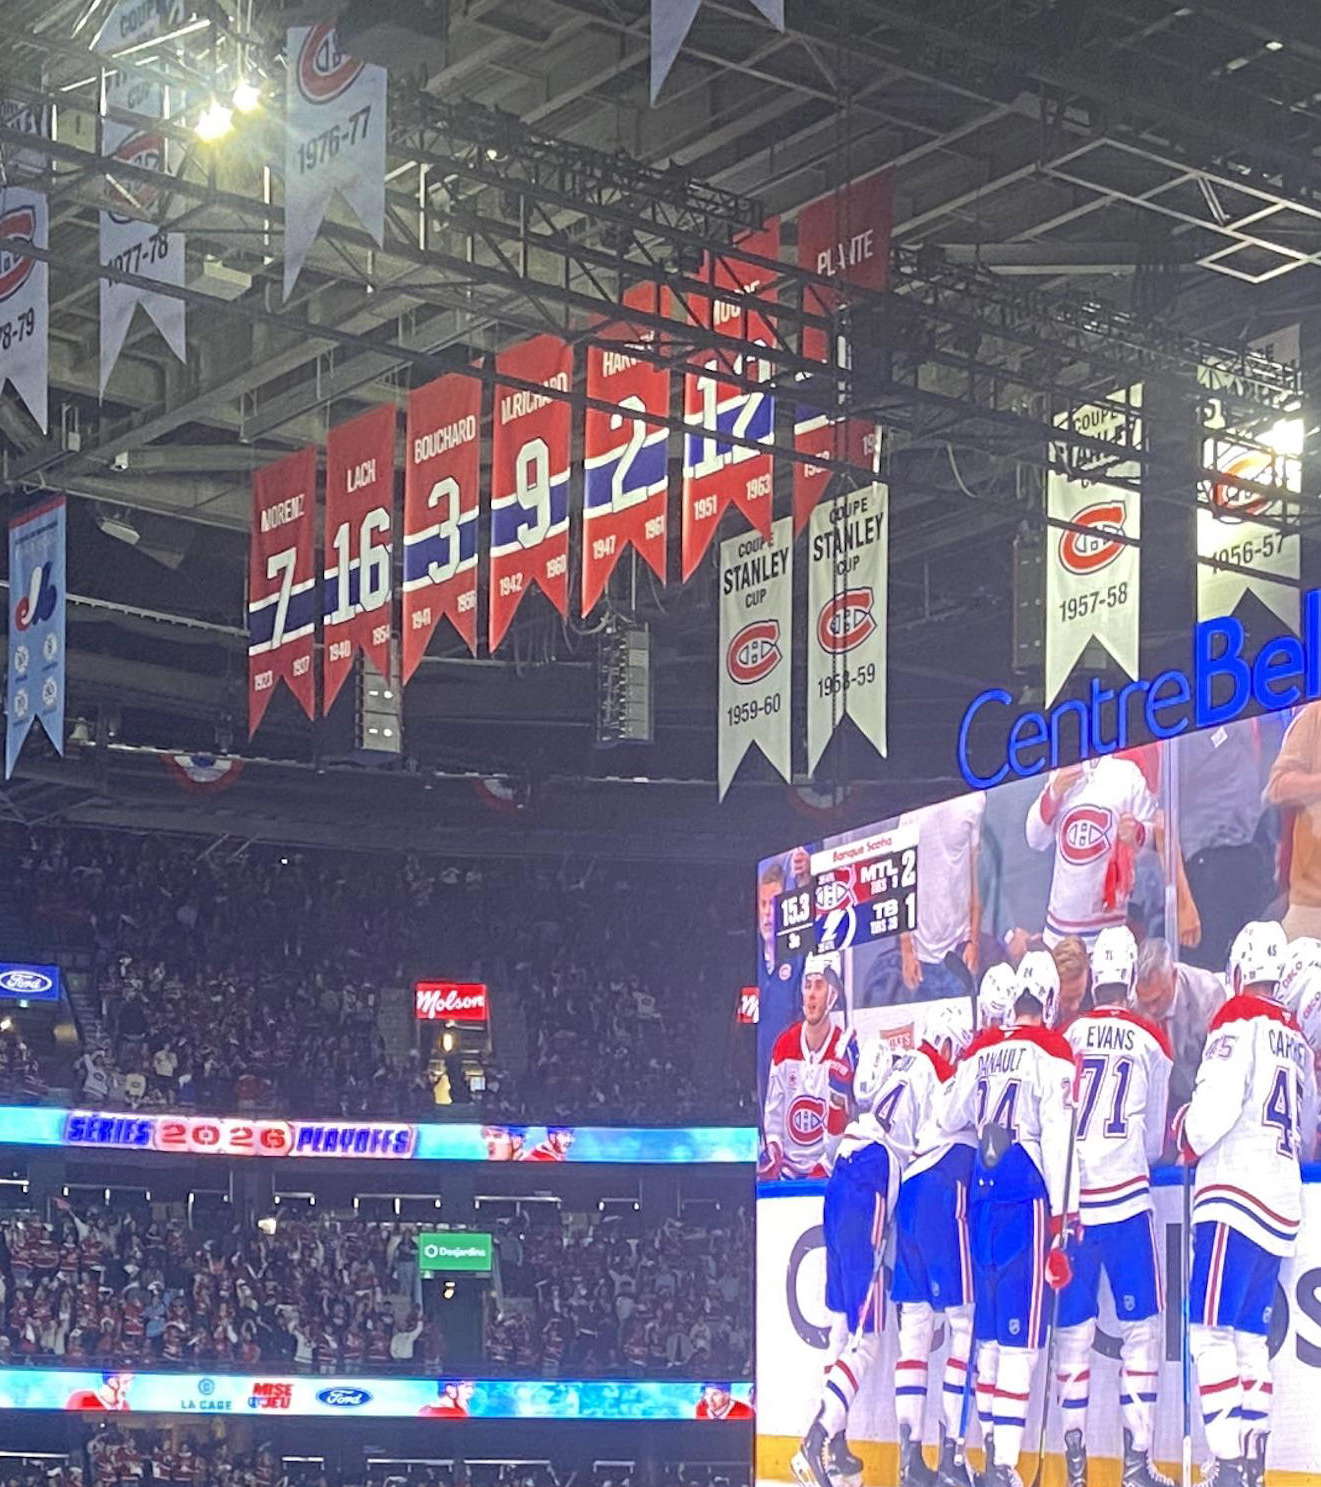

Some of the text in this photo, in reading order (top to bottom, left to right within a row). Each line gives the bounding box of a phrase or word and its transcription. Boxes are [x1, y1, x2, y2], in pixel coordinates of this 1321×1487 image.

[296, 105, 372, 176] 1976-77
[414, 414, 476, 465] BOUCHARD
[609, 395, 648, 514] 2
[346, 458, 377, 493] LACH
[516, 437, 551, 550] 9
[829, 496, 869, 526] COUPE
[428, 475, 461, 585] 3
[813, 510, 885, 563] STANLEY
[331, 507, 391, 626] 16
[723, 545, 790, 596] STANLEY
[837, 555, 861, 577] CUP
[266, 546, 297, 650] 7
[744, 588, 768, 609] CUP
[1058, 581, 1129, 623] 1957-58
[817, 662, 876, 698] 1958-59
[727, 692, 782, 727] 1959-60
[860, 849, 916, 888] MTL 2
[781, 892, 810, 928] 15.3
[872, 892, 916, 930] TB 1
[416, 990, 485, 1019] Molson
[1086, 1025, 1136, 1051] EVANS
[1075, 1054, 1135, 1141] 71
[67, 1112, 410, 1154] SÉRIES 2026 PLAYOFFS
[439, 1246, 487, 1260] Desjardins
[181, 1400, 233, 1411] LA CAGE
[252, 1382, 294, 1397] MISE
[261, 1397, 291, 1409] JEU
[327, 1389, 365, 1406] Ford
